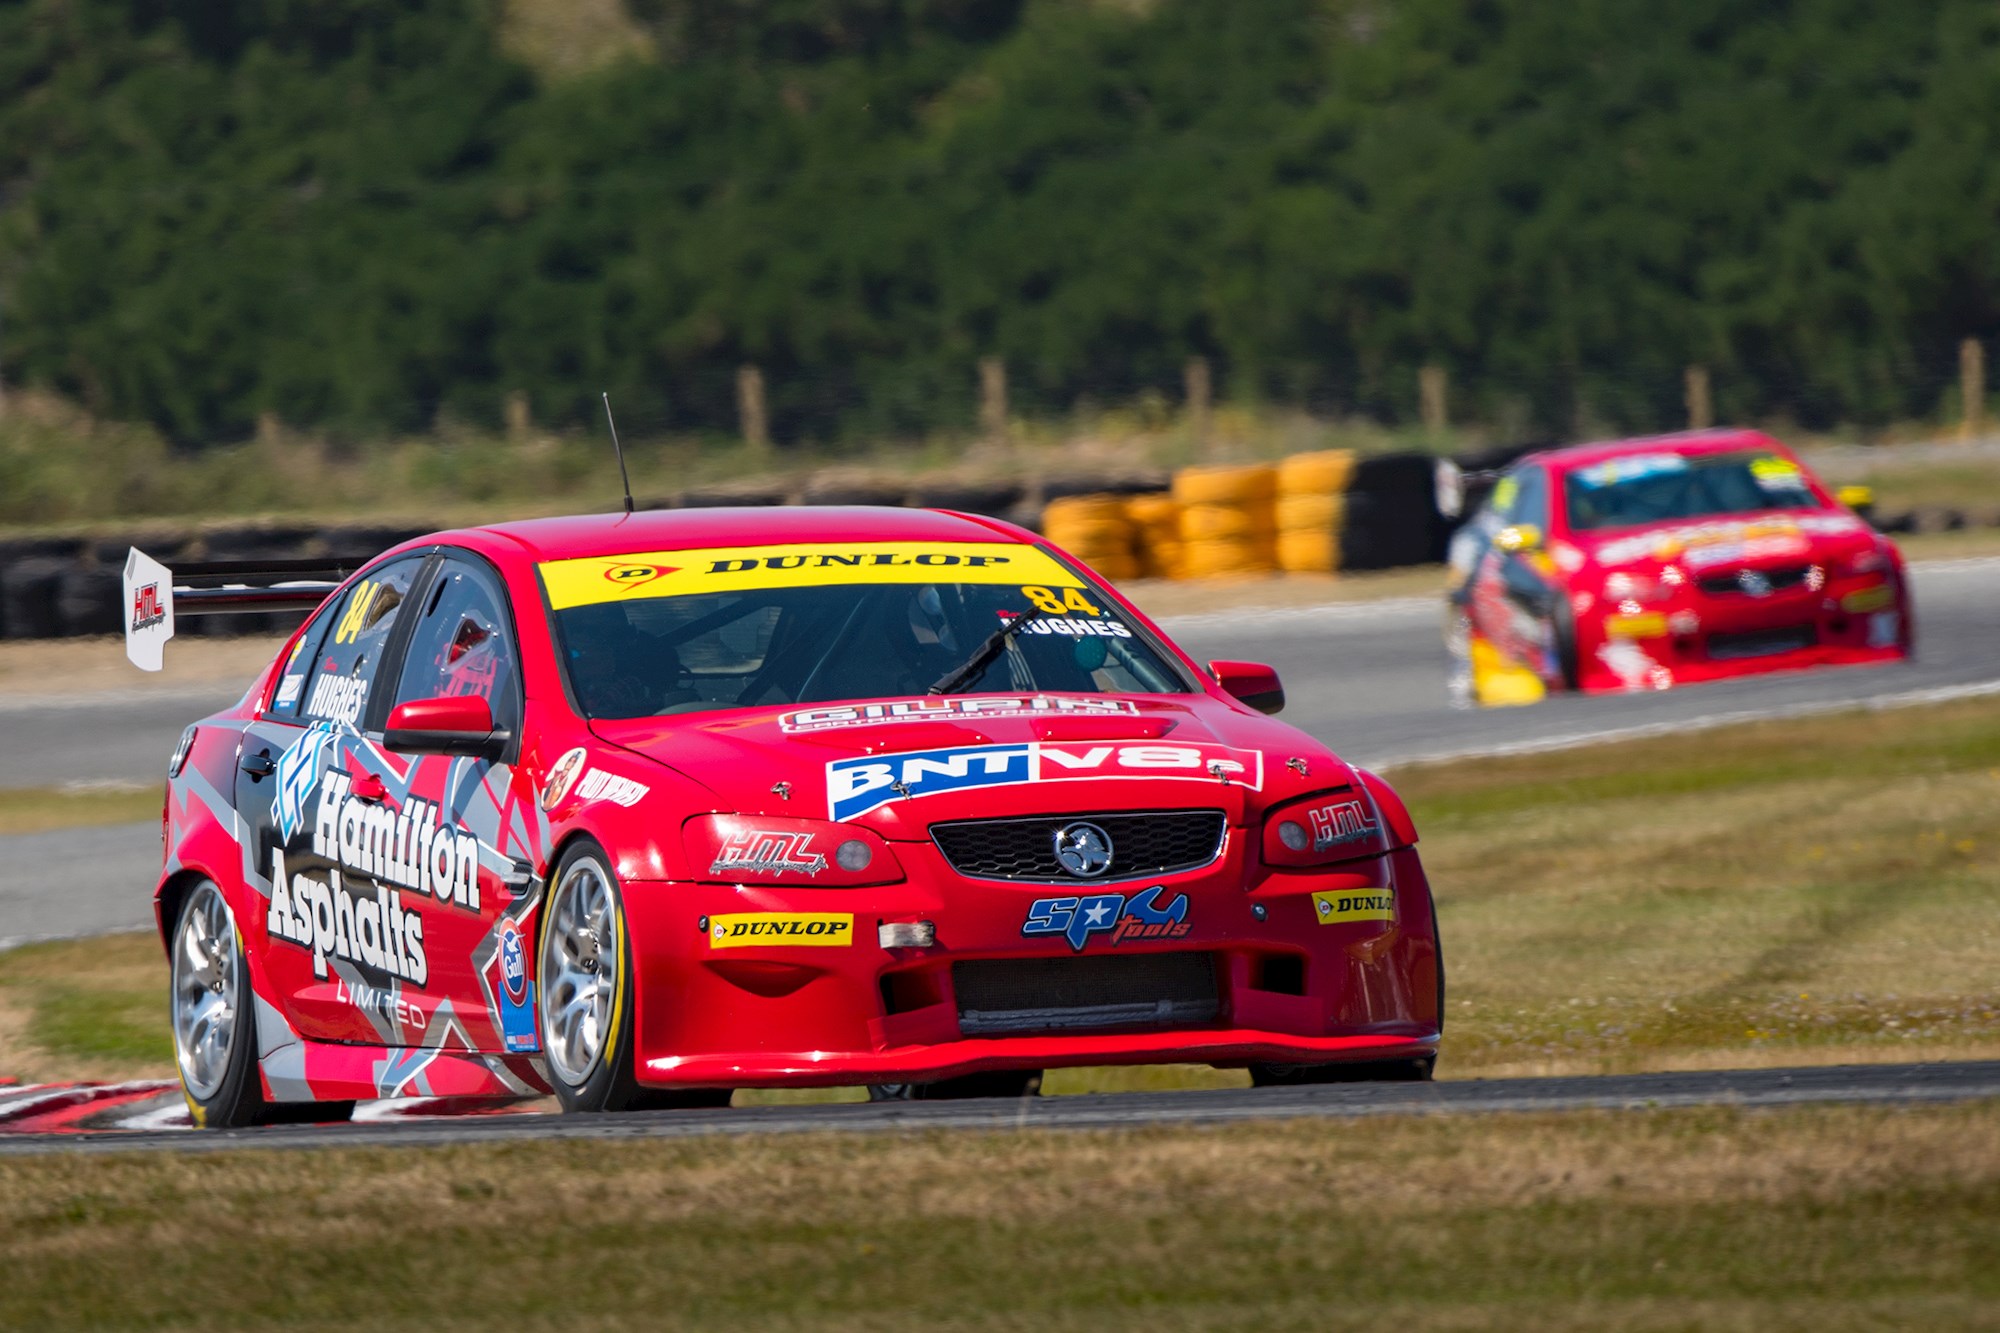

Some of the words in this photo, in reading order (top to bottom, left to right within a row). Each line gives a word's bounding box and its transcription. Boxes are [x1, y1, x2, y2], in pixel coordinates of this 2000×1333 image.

[704, 553, 1011, 575] DUNLOP
[133, 582, 164, 621] HML
[335, 579, 379, 645] 84
[1021, 585, 1100, 617] 84
[307, 673, 368, 725] HUGHES
[794, 698, 1121, 725] GILPIN
[829, 749, 1029, 797] BNT
[313, 769, 481, 910] Hamilton
[1308, 800, 1379, 842] HML
[714, 829, 822, 865] HML
[267, 846, 428, 986] Asphalts
[1023, 894, 1125, 950] SP
[1337, 897, 1393, 912] DUNLO
[730, 922, 848, 937] DUNLOP
[1111, 914, 1192, 947] tools
[504, 952, 524, 979] Gull
[336, 978, 426, 1029] LIMITED
